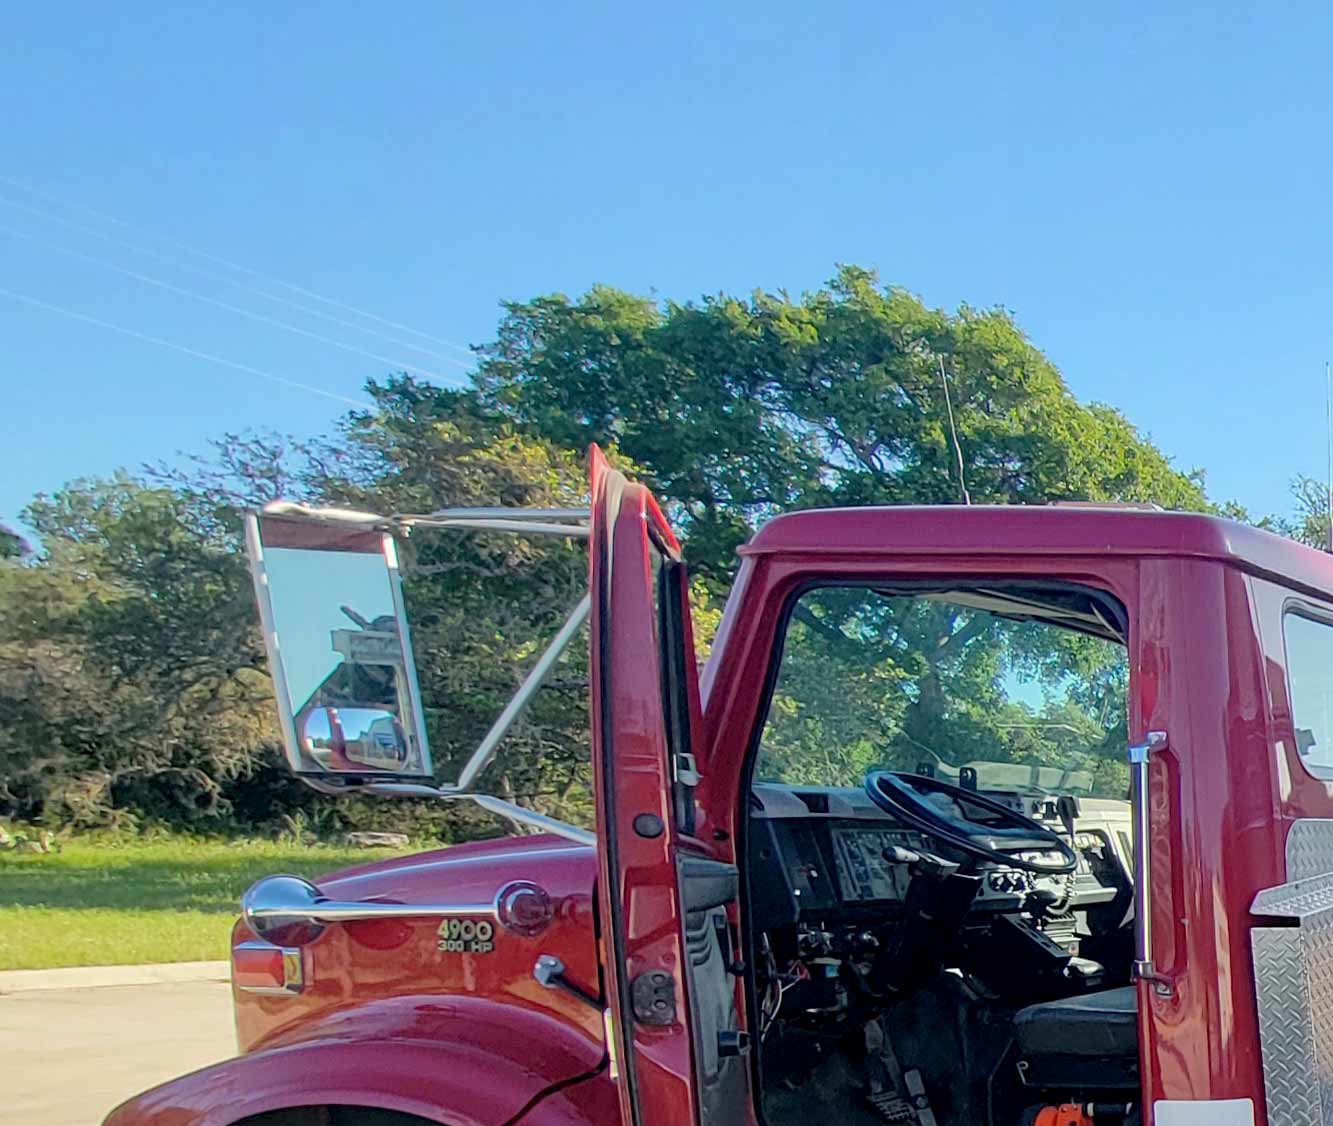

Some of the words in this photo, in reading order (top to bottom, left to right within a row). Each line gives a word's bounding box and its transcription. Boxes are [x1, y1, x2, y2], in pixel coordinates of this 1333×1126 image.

[437, 918, 493, 941] 4900
[437, 939, 465, 952] 300
[471, 940, 493, 953] HP
